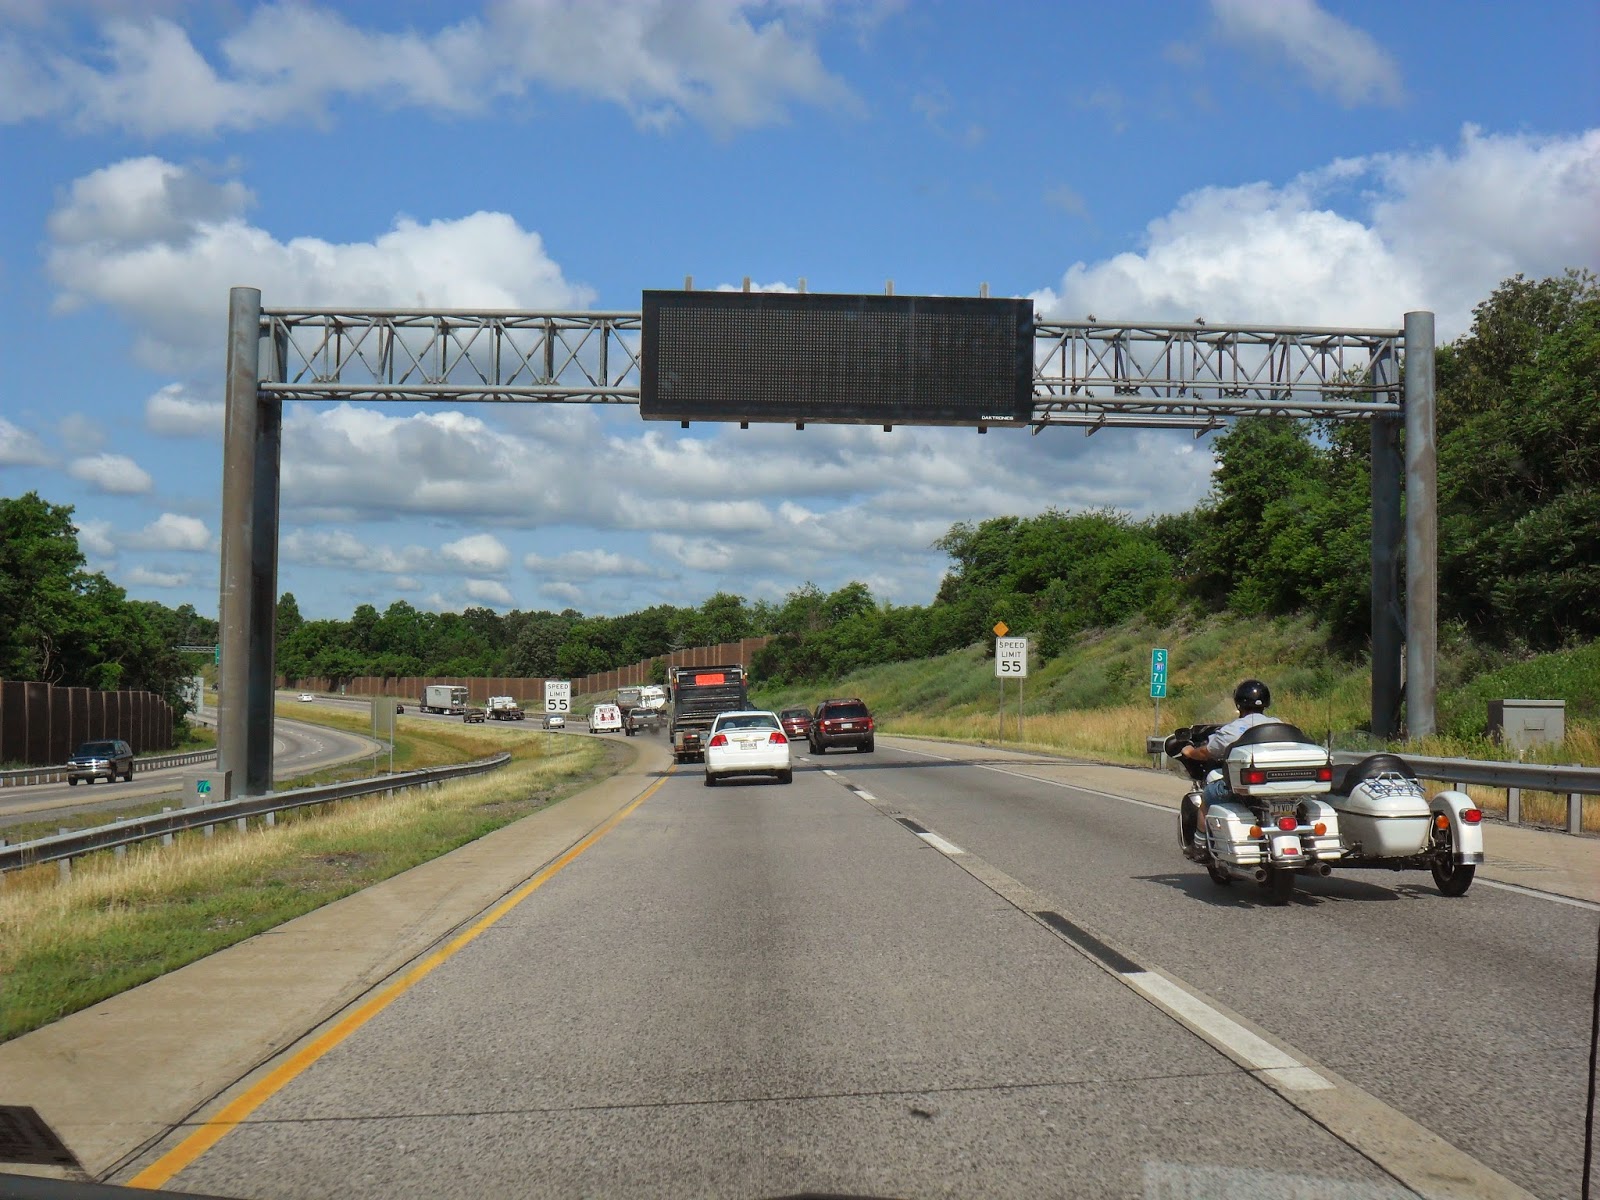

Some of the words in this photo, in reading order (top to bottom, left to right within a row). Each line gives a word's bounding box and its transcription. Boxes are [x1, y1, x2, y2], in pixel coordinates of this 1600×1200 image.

[1157, 652, 1163, 662] S
[1001, 660, 1021, 673] 55
[1153, 672, 1163, 683] 71
[548, 699, 568, 711] 55
